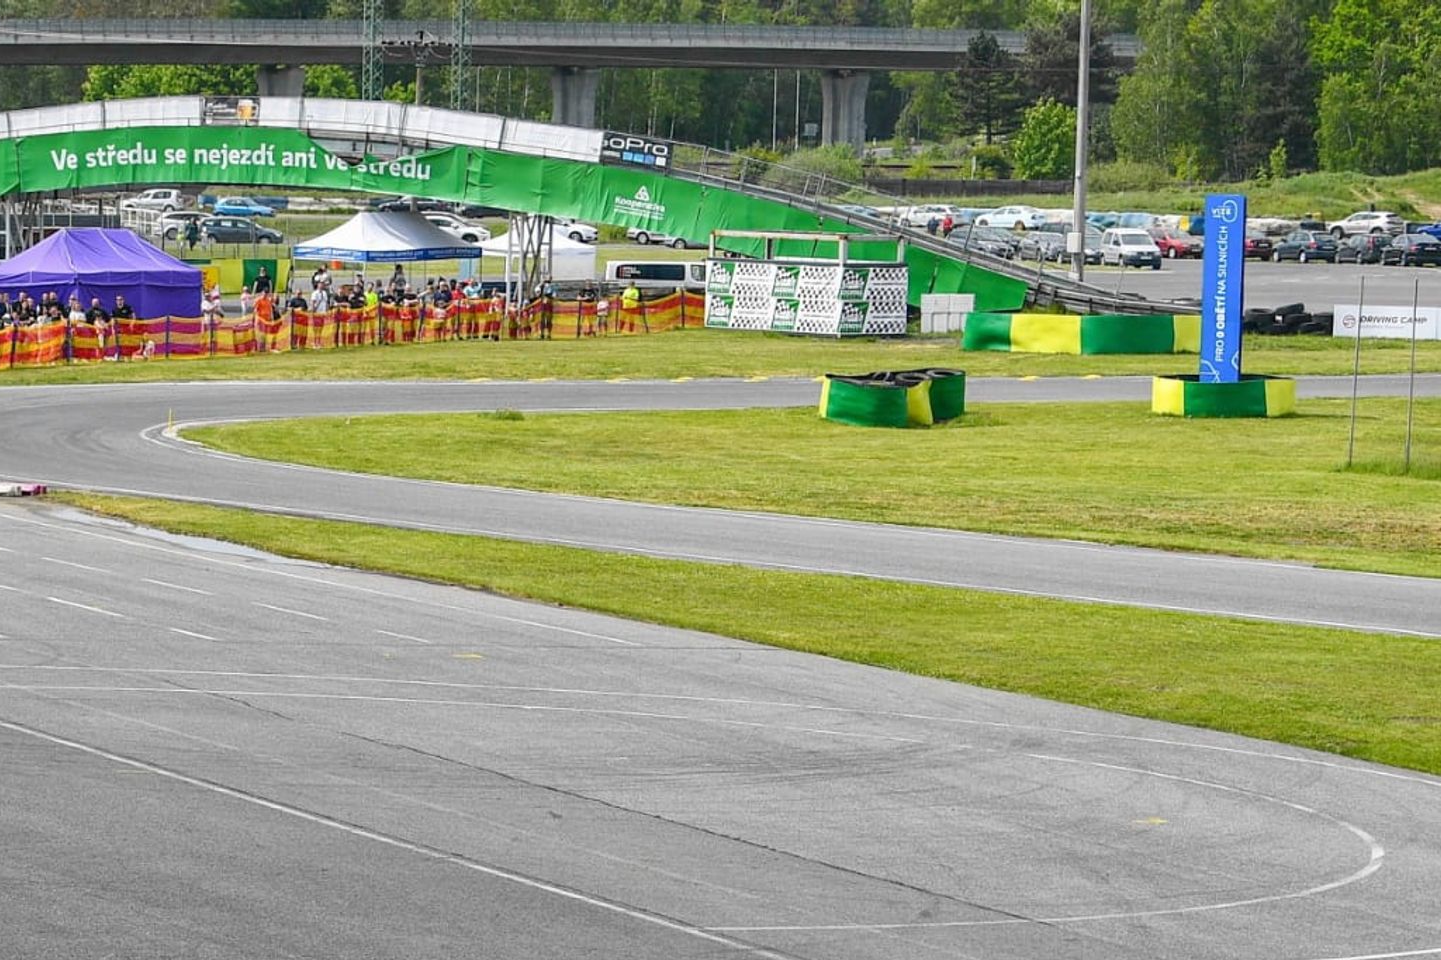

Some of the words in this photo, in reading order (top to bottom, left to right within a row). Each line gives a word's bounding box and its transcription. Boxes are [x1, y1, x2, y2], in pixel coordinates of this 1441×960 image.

[50, 149, 78, 171] Ve
[85, 142, 157, 168] středu
[164, 148, 187, 164] se
[194, 143, 275, 170] nejezdí
[281, 147, 317, 169] ani
[1217, 279, 1227, 294] NA
[1215, 340, 1225, 362] PRO
